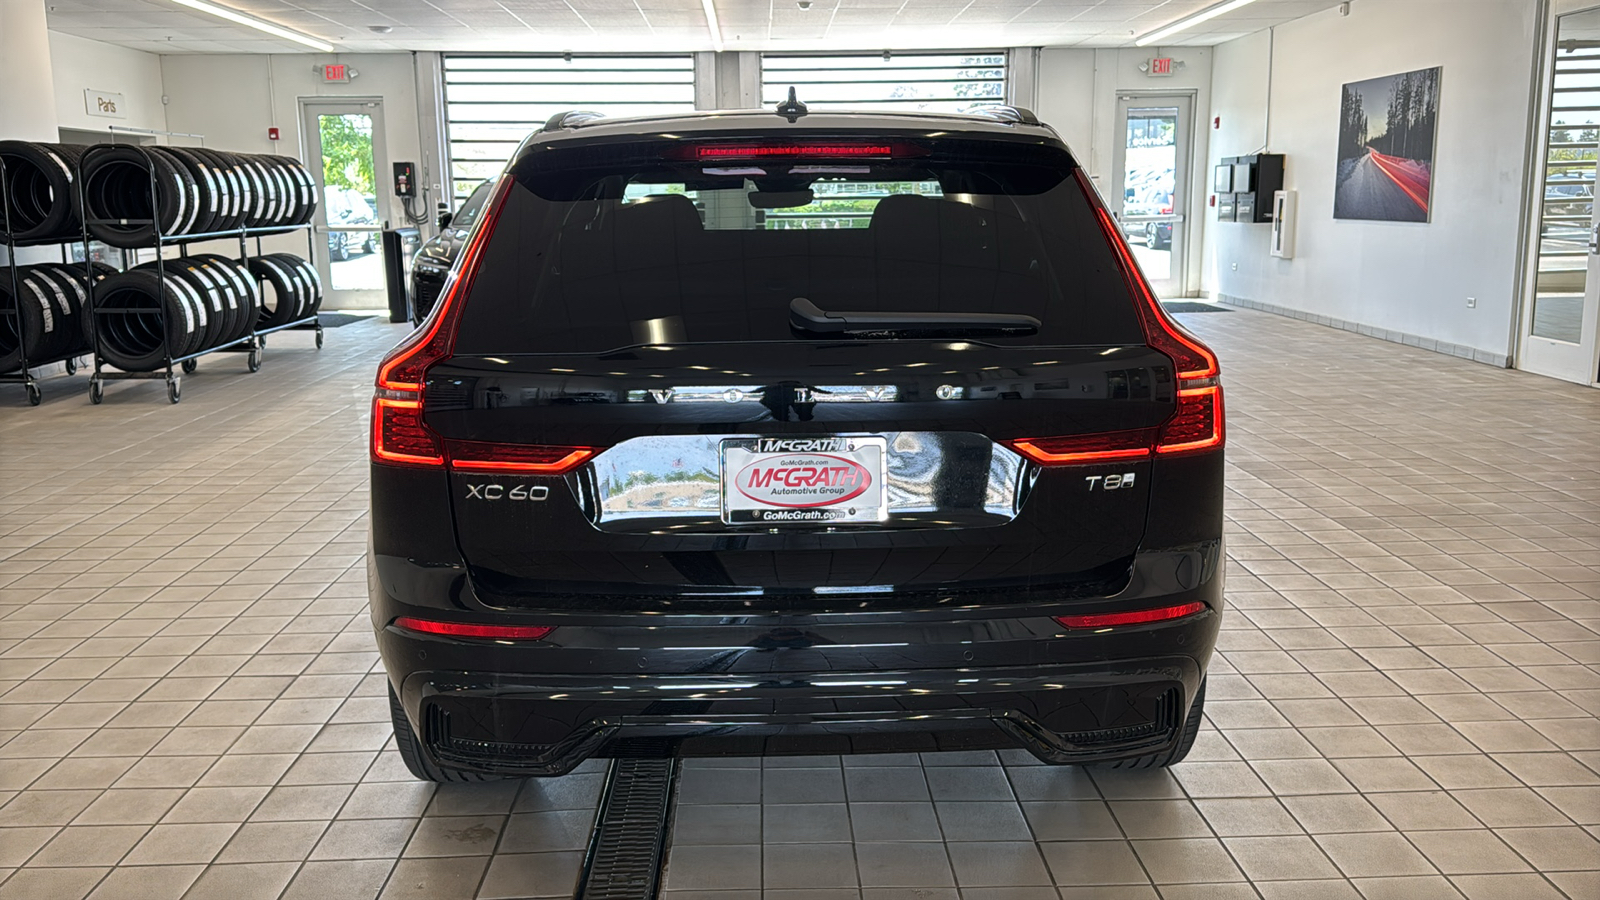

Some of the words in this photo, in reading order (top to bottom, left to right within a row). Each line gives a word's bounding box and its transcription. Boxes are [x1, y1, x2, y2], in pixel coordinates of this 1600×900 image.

[325, 64, 345, 80] EXIT
[1152, 57, 1171, 74] EXIT
[97, 96, 117, 114] Parts
[648, 384, 952, 405] VOLVO
[770, 487, 818, 496] Automotive
[819, 487, 845, 496] Group
[763, 510, 846, 521] GoMcGrath.com
